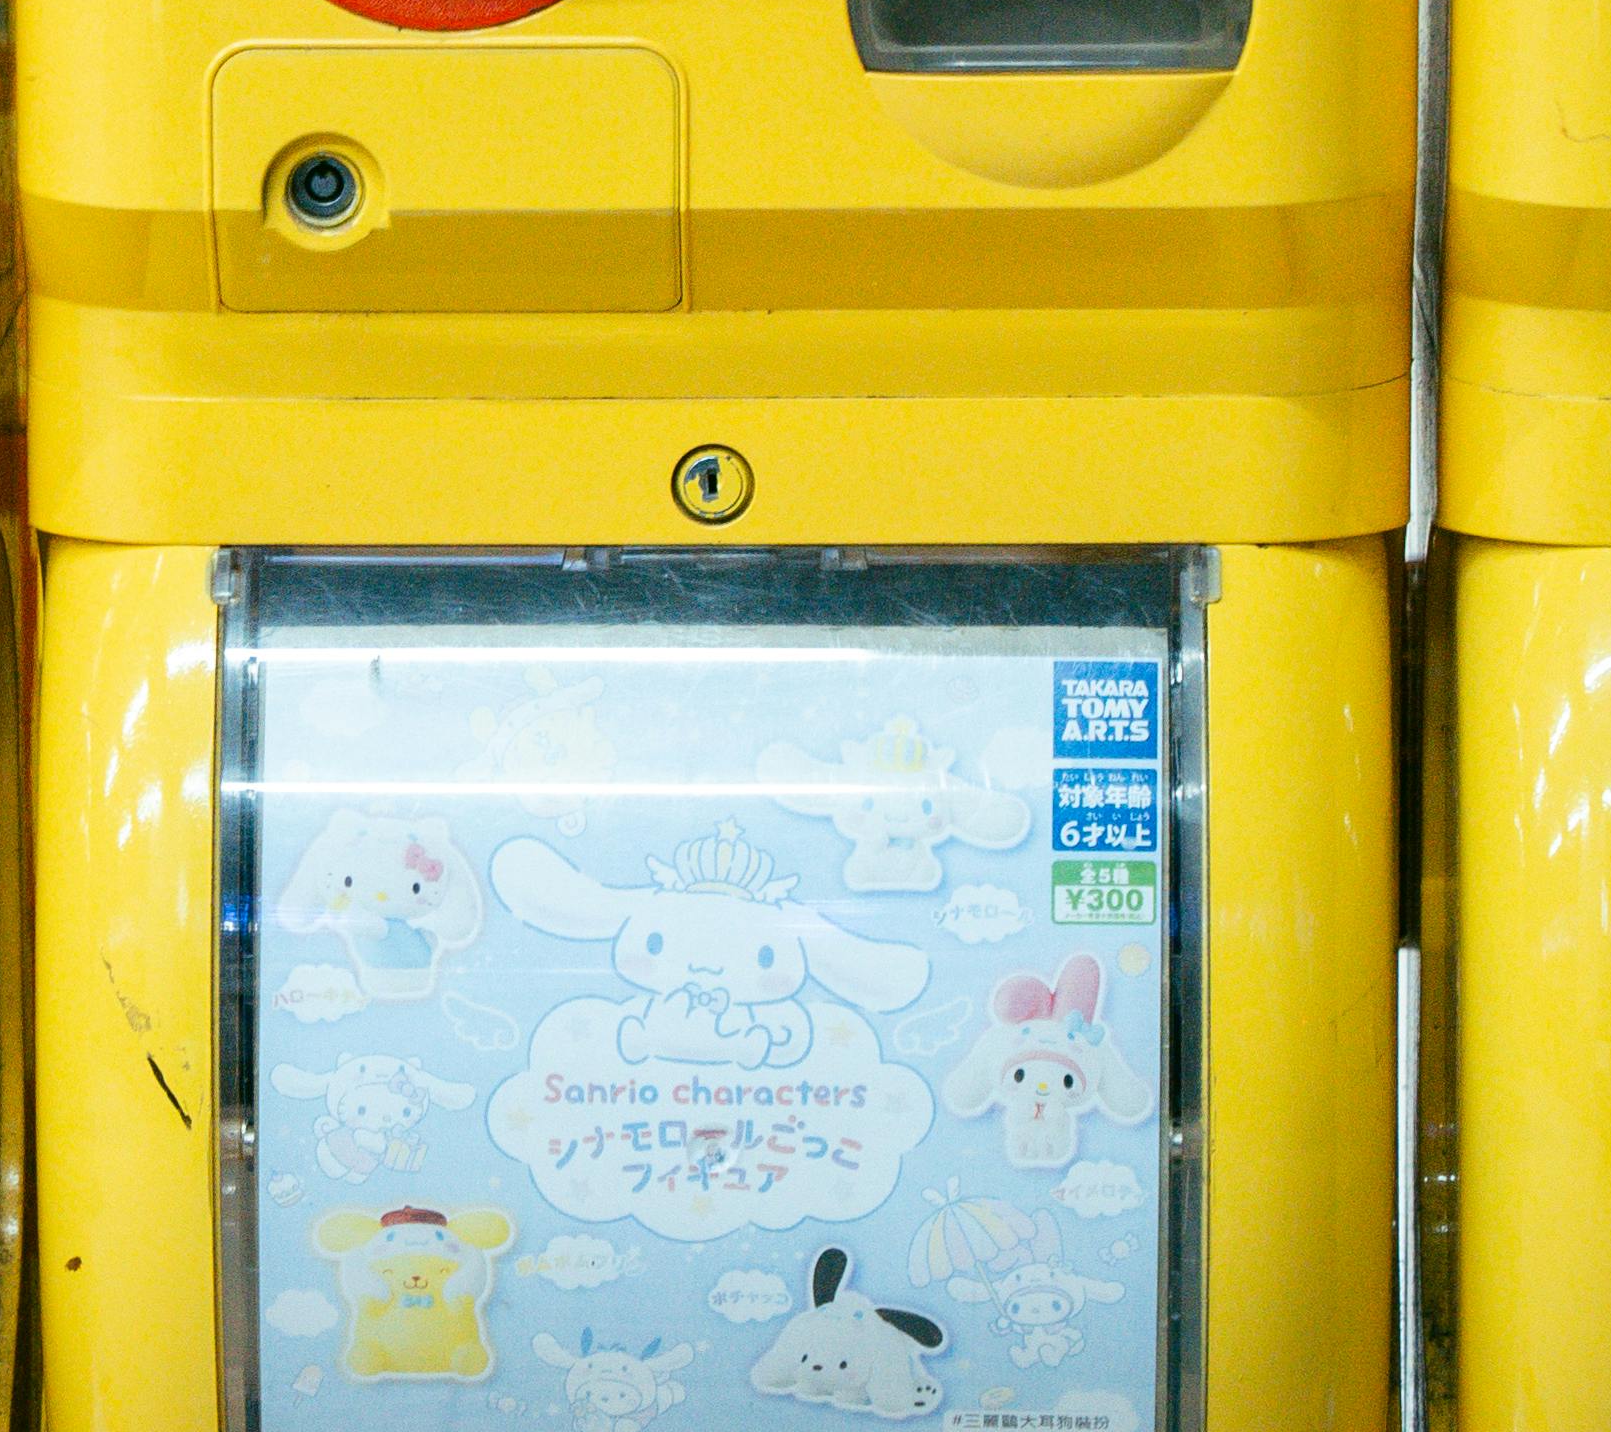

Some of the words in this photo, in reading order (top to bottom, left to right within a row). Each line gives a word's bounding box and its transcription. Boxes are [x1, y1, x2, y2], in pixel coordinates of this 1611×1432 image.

[1061, 679, 1149, 697] TAKARA
[1061, 698, 1149, 719] TOMY
[1058, 784, 1152, 810] 対象年齢
[1060, 820, 1152, 848] 6才以上
[1064, 888, 1144, 912] ¥300
[543, 1073, 660, 1106] Sanrio
[671, 1075, 868, 1110] characters
